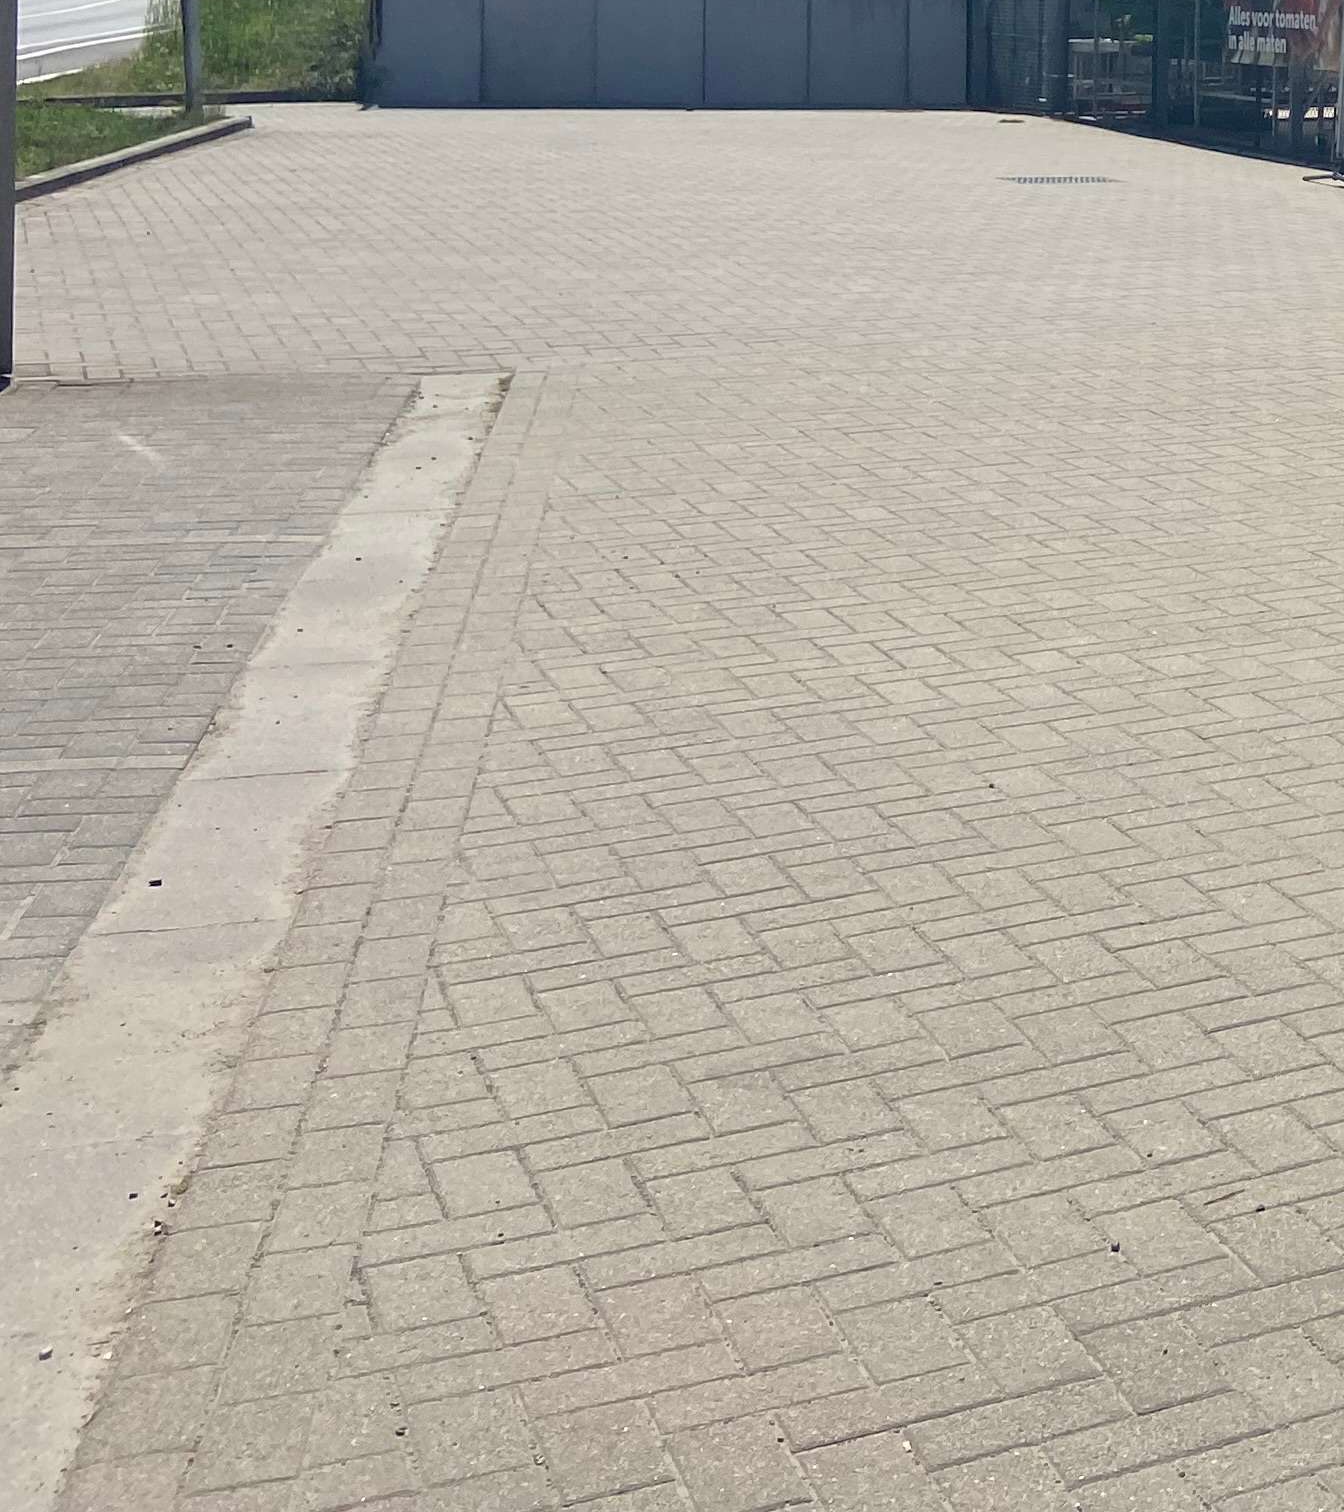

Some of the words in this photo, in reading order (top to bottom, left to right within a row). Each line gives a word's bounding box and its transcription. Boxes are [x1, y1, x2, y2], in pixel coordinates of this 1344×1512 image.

[1228, 5, 1251, 27] Alles
[1251, 10, 1275, 28] voor
[1228, 29, 1238, 49] in
[1238, 31, 1256, 51] alle
[1257, 33, 1287, 54] maten
